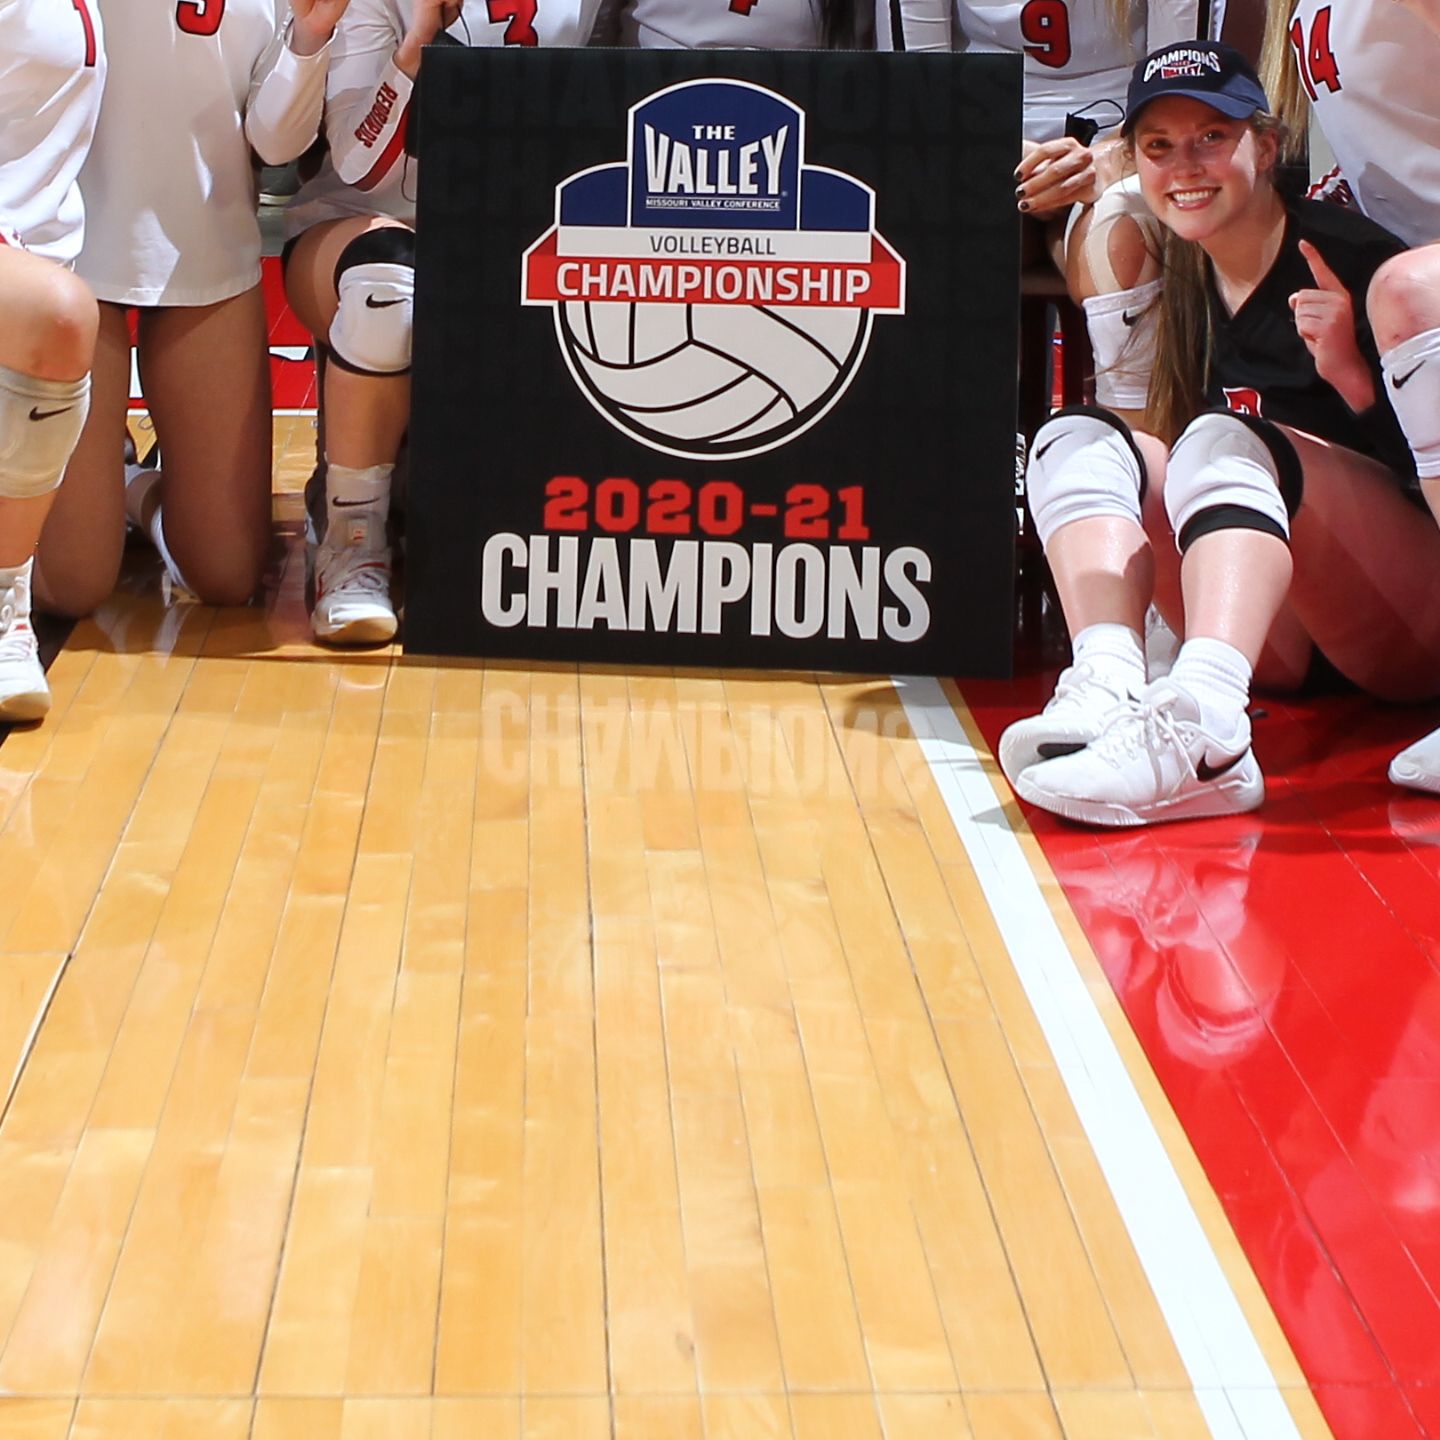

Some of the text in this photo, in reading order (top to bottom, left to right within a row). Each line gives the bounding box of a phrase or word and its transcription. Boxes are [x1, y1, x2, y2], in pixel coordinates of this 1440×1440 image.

[1144, 49, 1221, 82] CHAMPIONS
[1290, 5, 1343, 103] 14
[354, 81, 399, 148] REDBIRDS
[692, 125, 736, 140] THE
[644, 123, 789, 195] VALLEY
[646, 199, 780, 209] MISSOURI VALLEY CONFERENCE
[650, 235, 777, 256] VOLLEYBALL
[556, 261, 872, 303] CHAMPIONSHIP
[543, 475, 871, 541] 2020-21
[481, 533, 933, 643] CHAMPIONS
